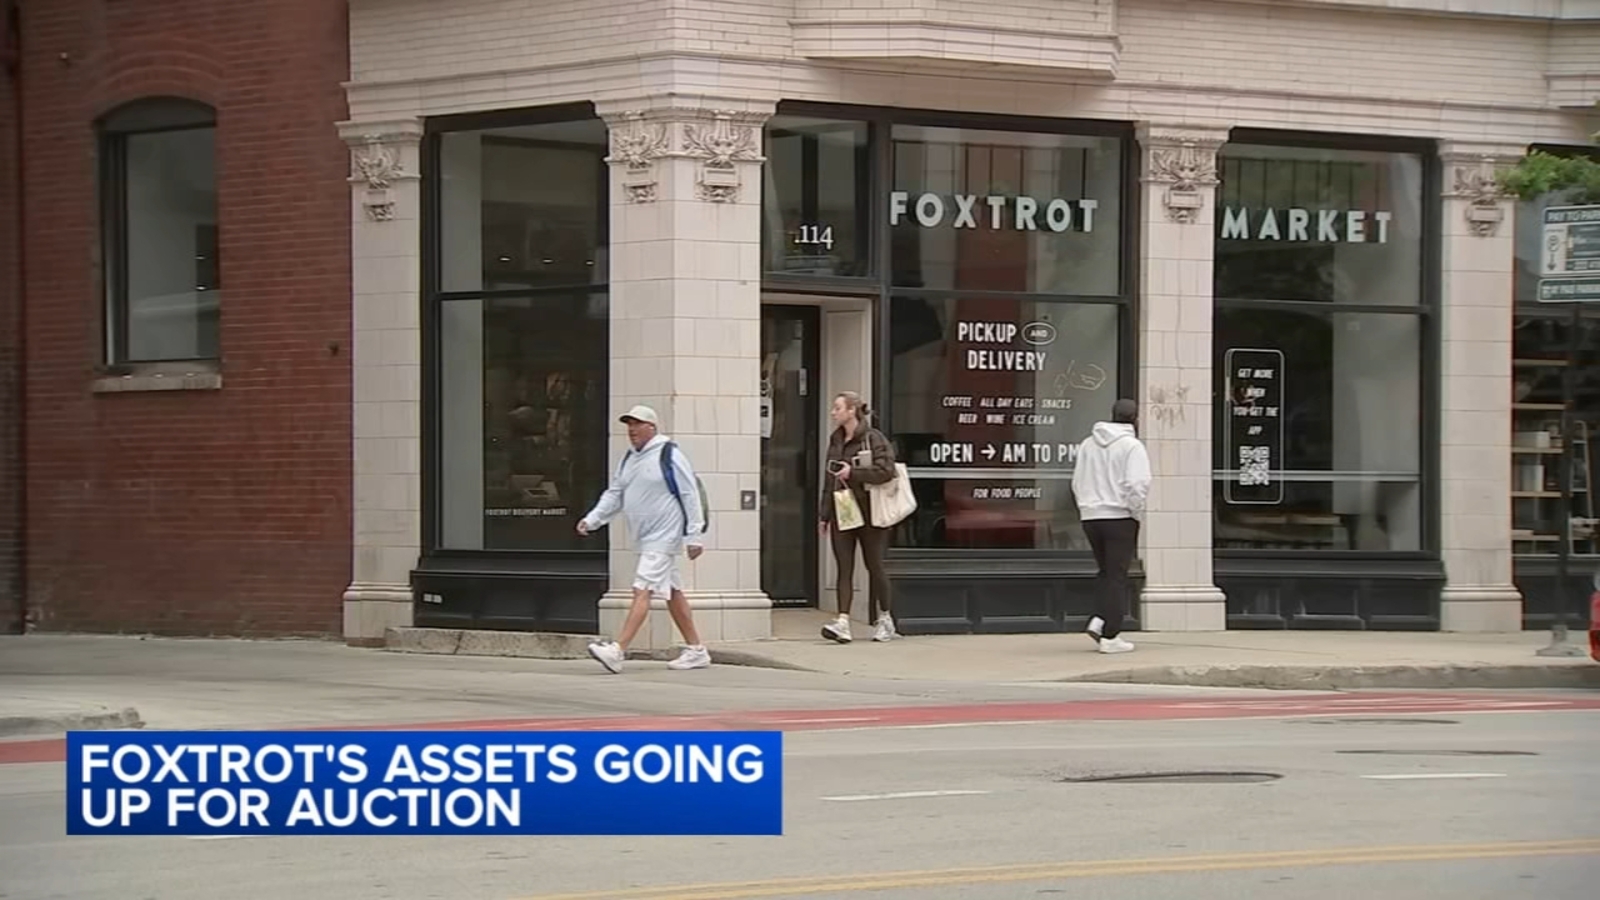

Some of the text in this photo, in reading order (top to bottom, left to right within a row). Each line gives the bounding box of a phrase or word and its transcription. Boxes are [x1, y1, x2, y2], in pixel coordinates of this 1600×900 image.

[890, 191, 1098, 233] FOXTROT
[1220, 206, 1392, 244] MARKET
[957, 322, 1048, 343] PICKUP AND
[967, 350, 1046, 371] DELIVERY
[942, 396, 1072, 409] COFFEE ALL DAY EATS SNACKS
[958, 413, 1056, 425] BEER WINE ICE CREAM
[930, 443, 1080, 462] OPEN AM TO PM
[973, 488, 1042, 498] FOR FOOD PEOPLE
